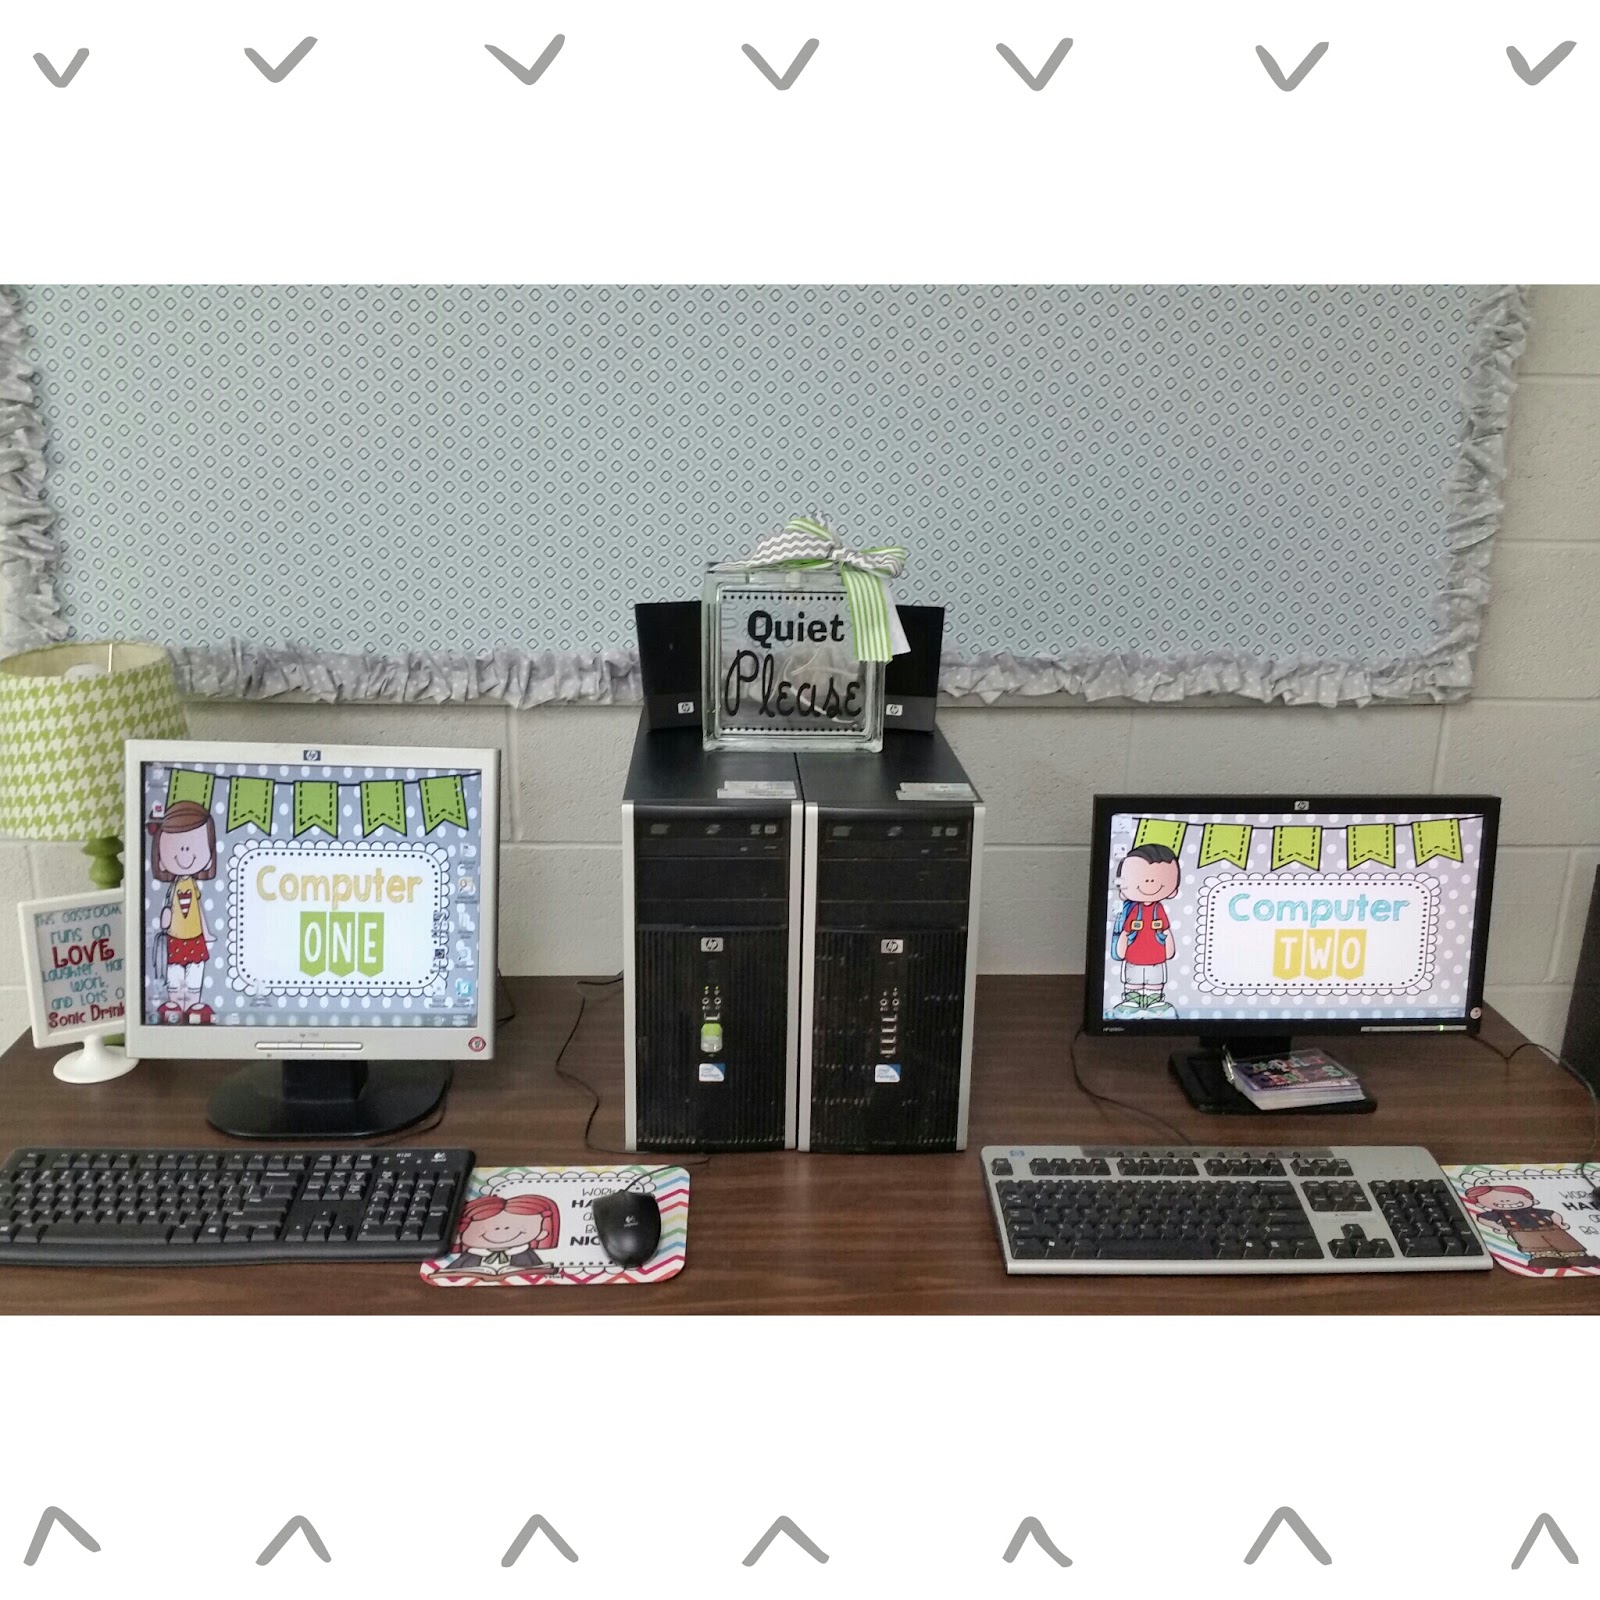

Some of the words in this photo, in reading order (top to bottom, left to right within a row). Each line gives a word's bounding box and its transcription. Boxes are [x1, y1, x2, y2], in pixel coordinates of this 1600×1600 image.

[747, 610, 845, 648] Quiet
[724, 649, 861, 718] Please
[256, 865, 423, 910] Computer
[1228, 893, 1410, 928] Computer
[50, 928, 82, 944] runs
[92, 923, 111, 940] on
[304, 921, 378, 963] ONE
[52, 938, 115, 969] LOVE
[1280, 937, 1361, 969] TWO
[48, 1011, 86, 1028] Sonic
[90, 1001, 125, 1021] Drink
[571, 1200, 594, 1208] HA
[569, 1236, 601, 1246] NIC
